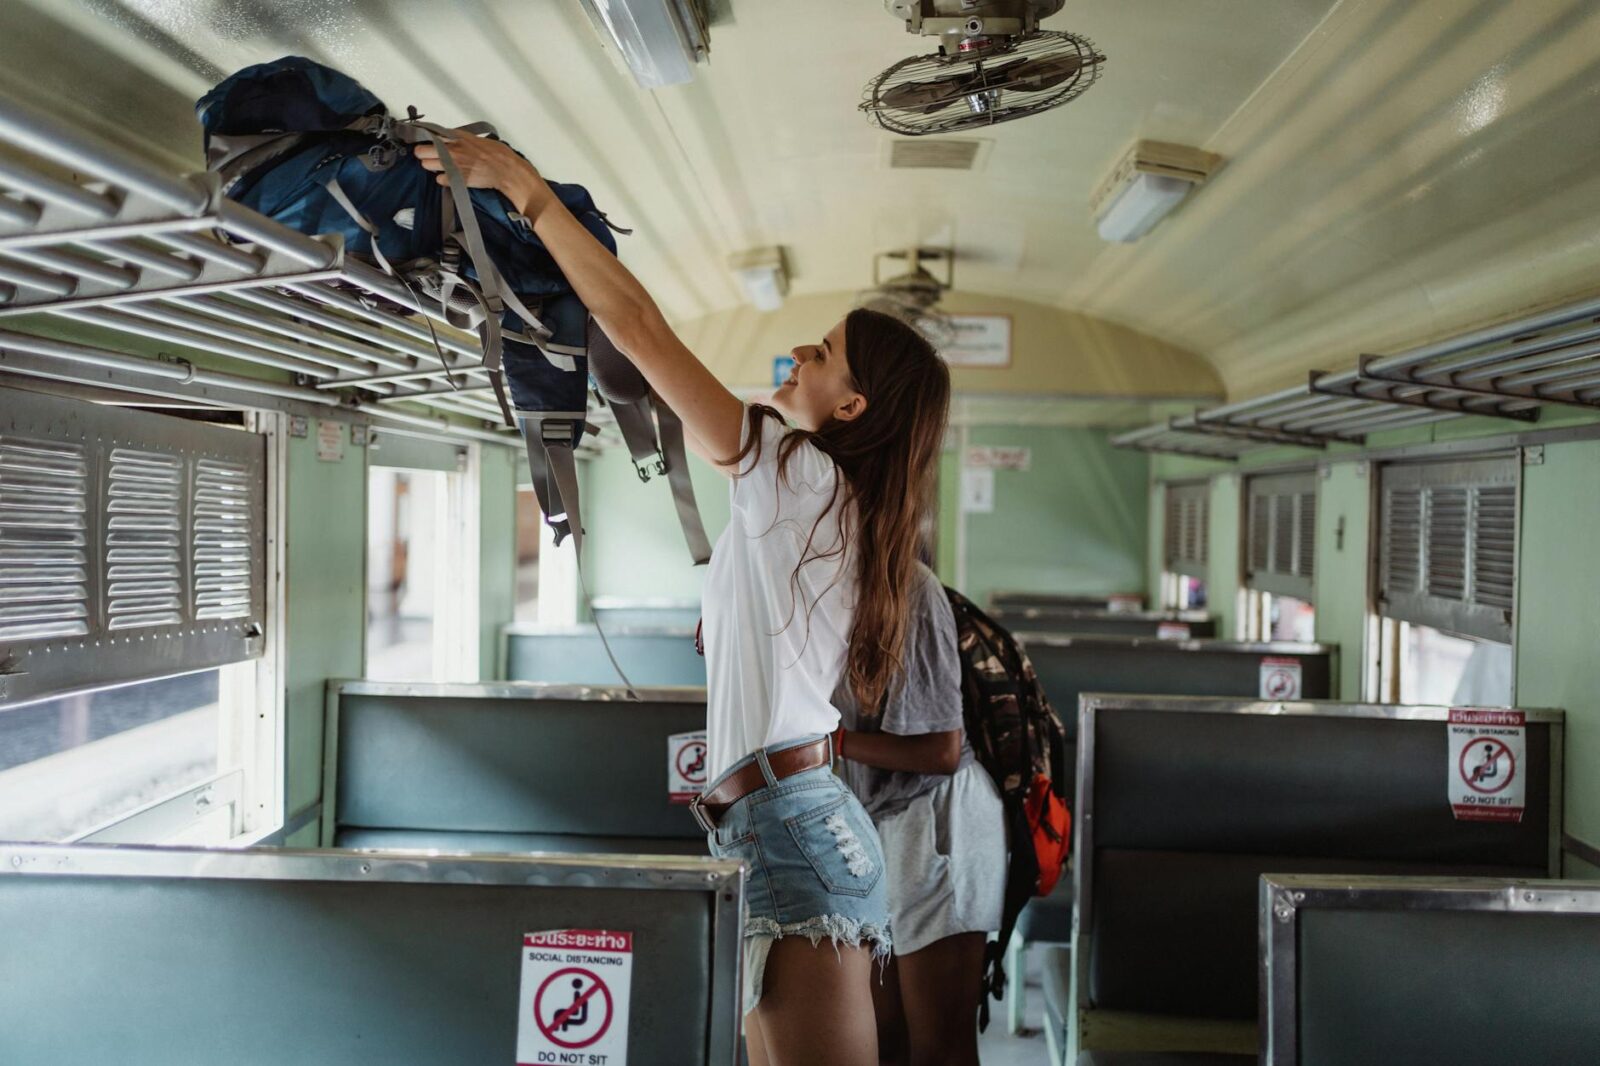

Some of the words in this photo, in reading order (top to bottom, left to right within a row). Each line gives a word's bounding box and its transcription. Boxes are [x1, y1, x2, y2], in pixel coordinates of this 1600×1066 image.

[1479, 728, 1519, 736] DISTANCING
[1463, 796, 1476, 804] DO
[1478, 796, 1496, 804] NOT
[1499, 797, 1512, 805] SIT
[529, 952, 563, 962] SOCIAL
[566, 954, 623, 966] DISTANCING
[538, 1051, 556, 1062] DO
[560, 1052, 585, 1064] NOT
[589, 1054, 608, 1065] SIT
